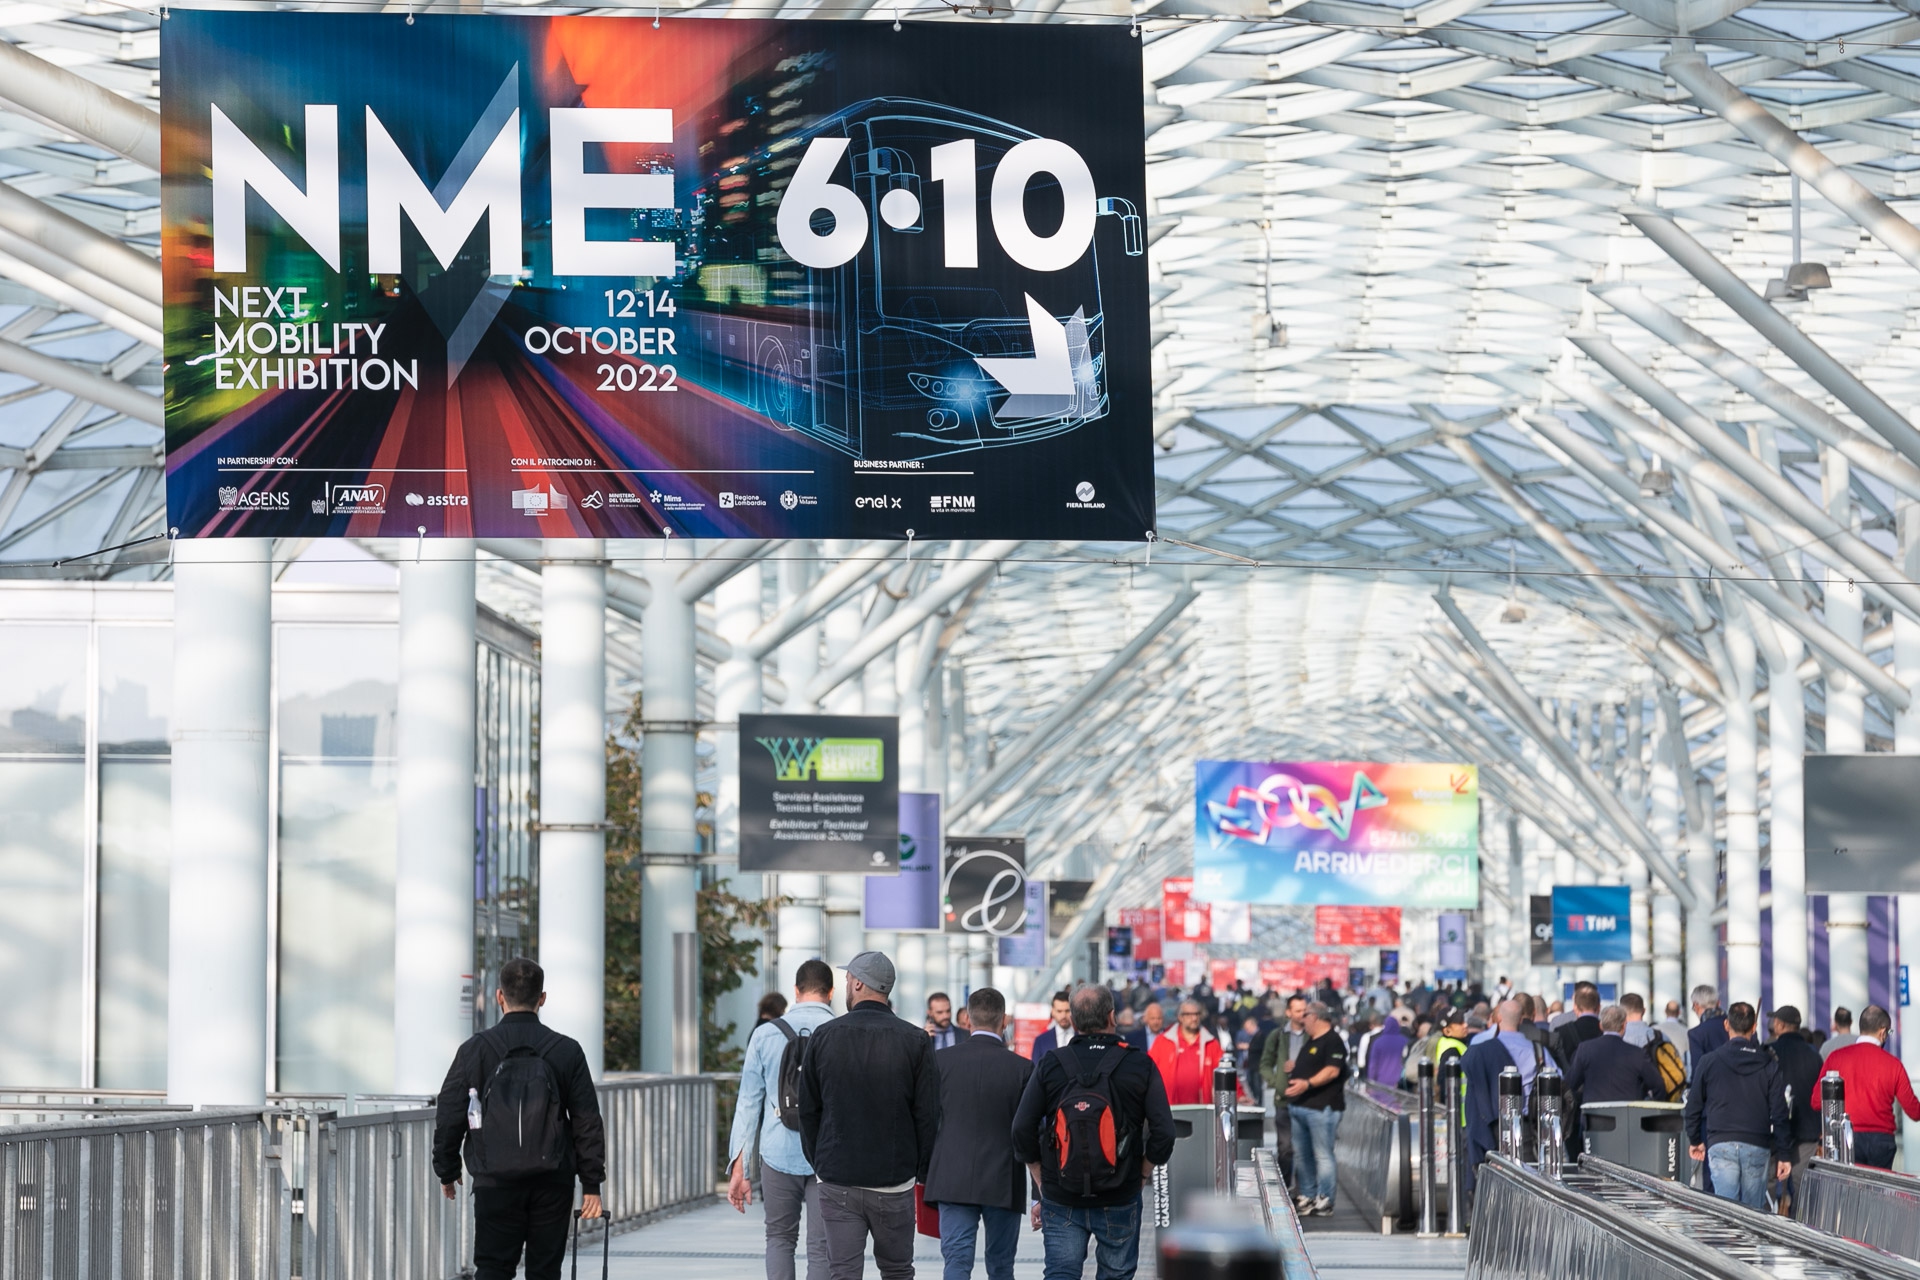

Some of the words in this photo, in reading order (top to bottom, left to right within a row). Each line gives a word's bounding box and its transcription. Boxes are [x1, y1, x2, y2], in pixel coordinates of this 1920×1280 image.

[210, 101, 677, 276] NME
[213, 286, 308, 318] NEXT
[214, 322, 387, 355] MOBILITY
[524, 326, 678, 356] OCTOBER
[214, 358, 419, 391] EXHIBITION
[596, 363, 679, 393] 2022
[217, 457, 225, 465] IN
[226, 457, 275, 465] PARTNERSHIP
[276, 457, 294, 465] CON
[510, 457, 528, 466] CON
[529, 458, 536, 466] IL
[537, 458, 583, 466] PATROCINIO
[853, 460, 888, 468] BUSINESS
[888, 461, 921, 469] PARTNER
[238, 491, 290, 506] AGENS
[340, 489, 379, 502] ANAV
[426, 493, 469, 506] asstra
[663, 494, 682, 503] Mims
[734, 494, 760, 502] Regione
[855, 494, 888, 508] enel
[943, 495, 976, 508] FNM
[821, 755, 878, 772] SERVICE
[772, 792, 812, 803] Servizio
[812, 792, 865, 803] Assistenza
[775, 803, 812, 813] Tecnica
[823, 819, 869, 830] Technical
[773, 831, 827, 841] Assistance
[827, 831, 864, 842] Service
[1293, 850, 1470, 877] ARRIVEDERCI
[1585, 915, 1617, 932] TIM
